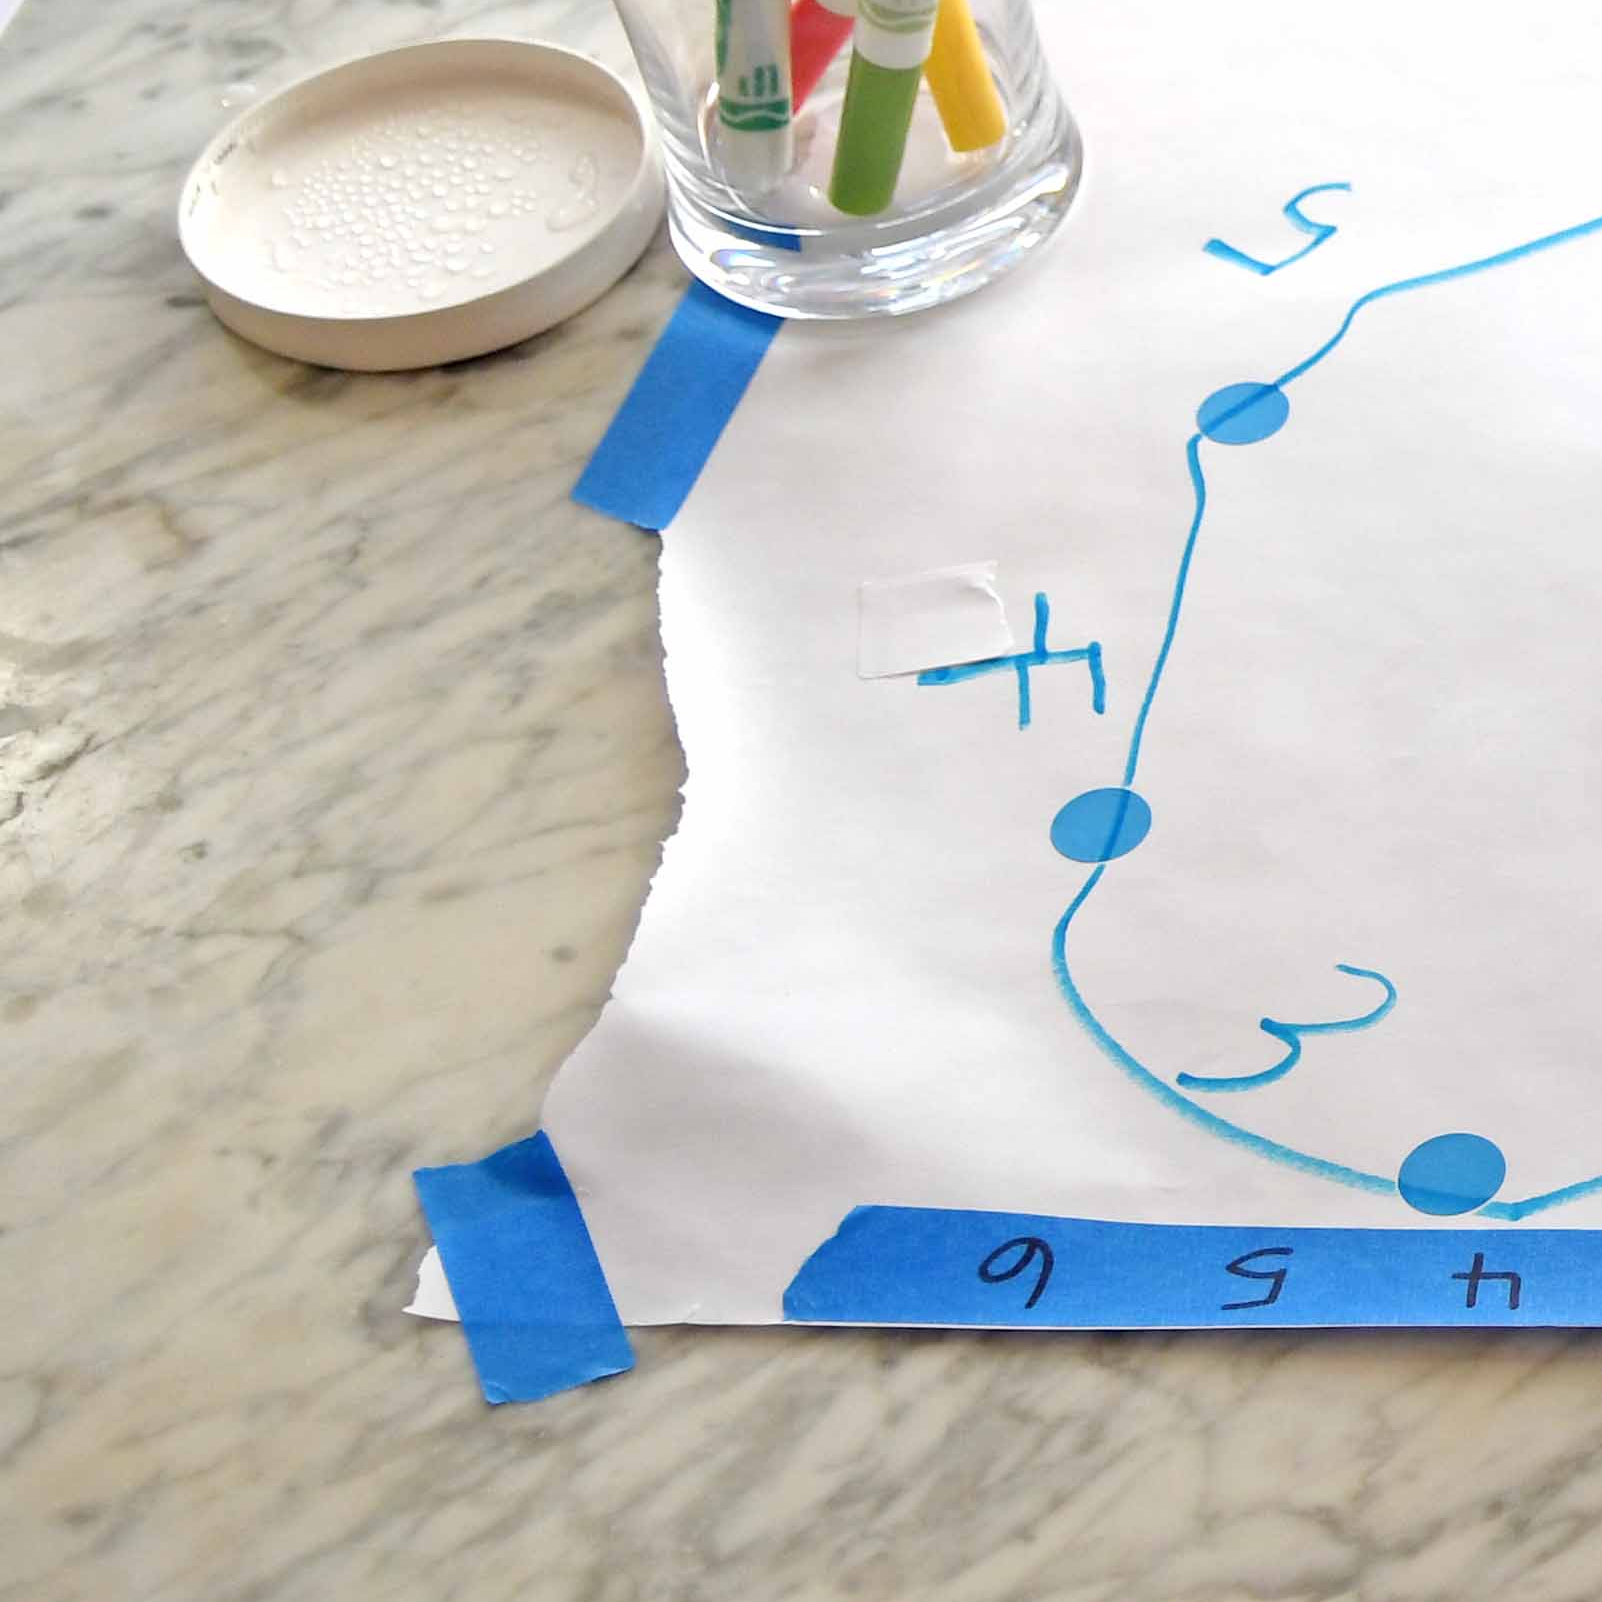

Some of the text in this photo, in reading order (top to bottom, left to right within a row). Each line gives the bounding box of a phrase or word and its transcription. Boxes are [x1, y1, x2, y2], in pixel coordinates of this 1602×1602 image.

[978, 1236, 1051, 1310] 6
[1225, 1247, 1293, 1310] 5
[1452, 1253, 1522, 1310] 4
